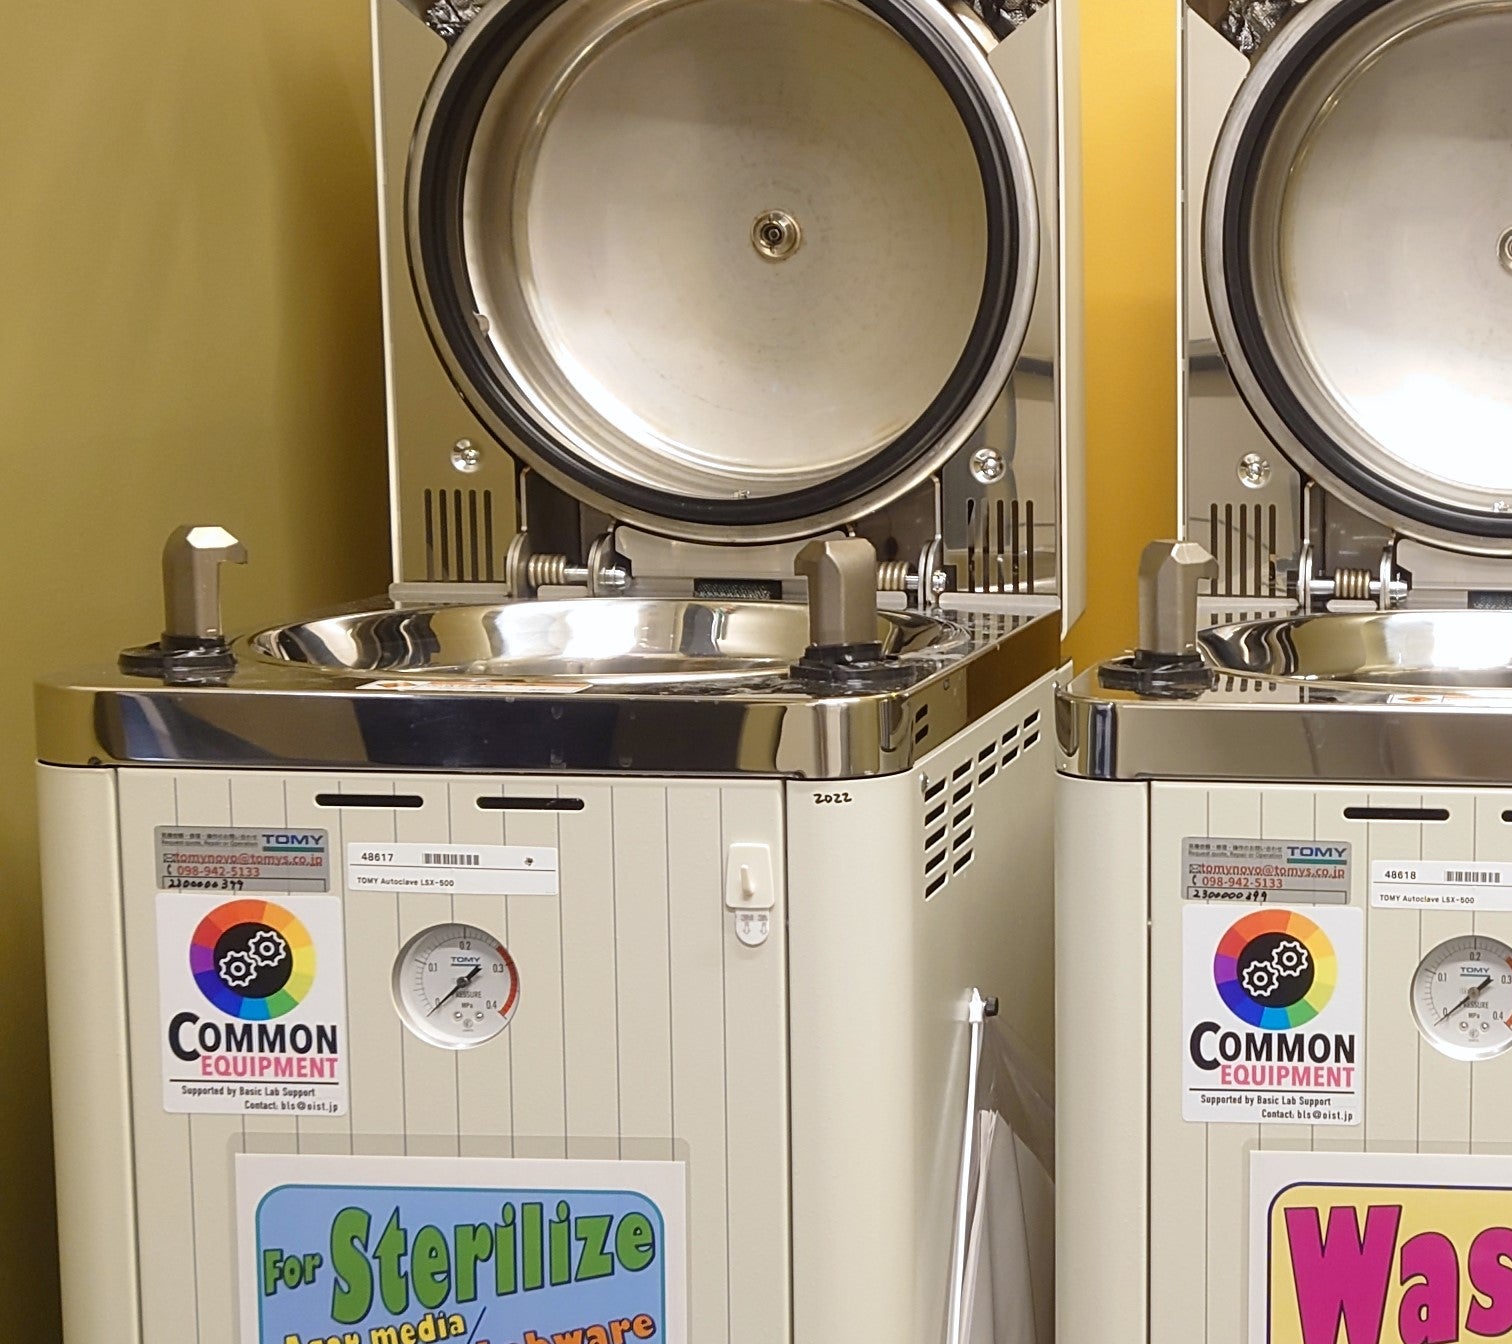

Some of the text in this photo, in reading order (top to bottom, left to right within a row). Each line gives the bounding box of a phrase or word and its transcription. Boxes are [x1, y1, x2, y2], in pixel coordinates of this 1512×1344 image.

[814, 792, 852, 804] 2022
[262, 834, 324, 846] TOMY
[361, 852, 394, 862] 48617
[1287, 846, 1347, 858] TOMY
[177, 866, 260, 877] 098-942-5133
[1385, 870, 1417, 880] 48618
[357, 877, 454, 887] TOMY Autoclave LSX-500
[1202, 876, 1283, 888] 098-942-5133
[169, 1012, 338, 1060] COMMON
[1190, 1021, 1355, 1070] COMMON
[201, 1056, 338, 1078] EQUIPMENT
[1221, 1065, 1354, 1087] EQUIPMENT
[182, 1085, 315, 1098] Supported by Basic Lab Support
[245, 1100, 338, 1113] Contact: bls@oist.jp
[263, 1200, 655, 1324] For Sterilize
